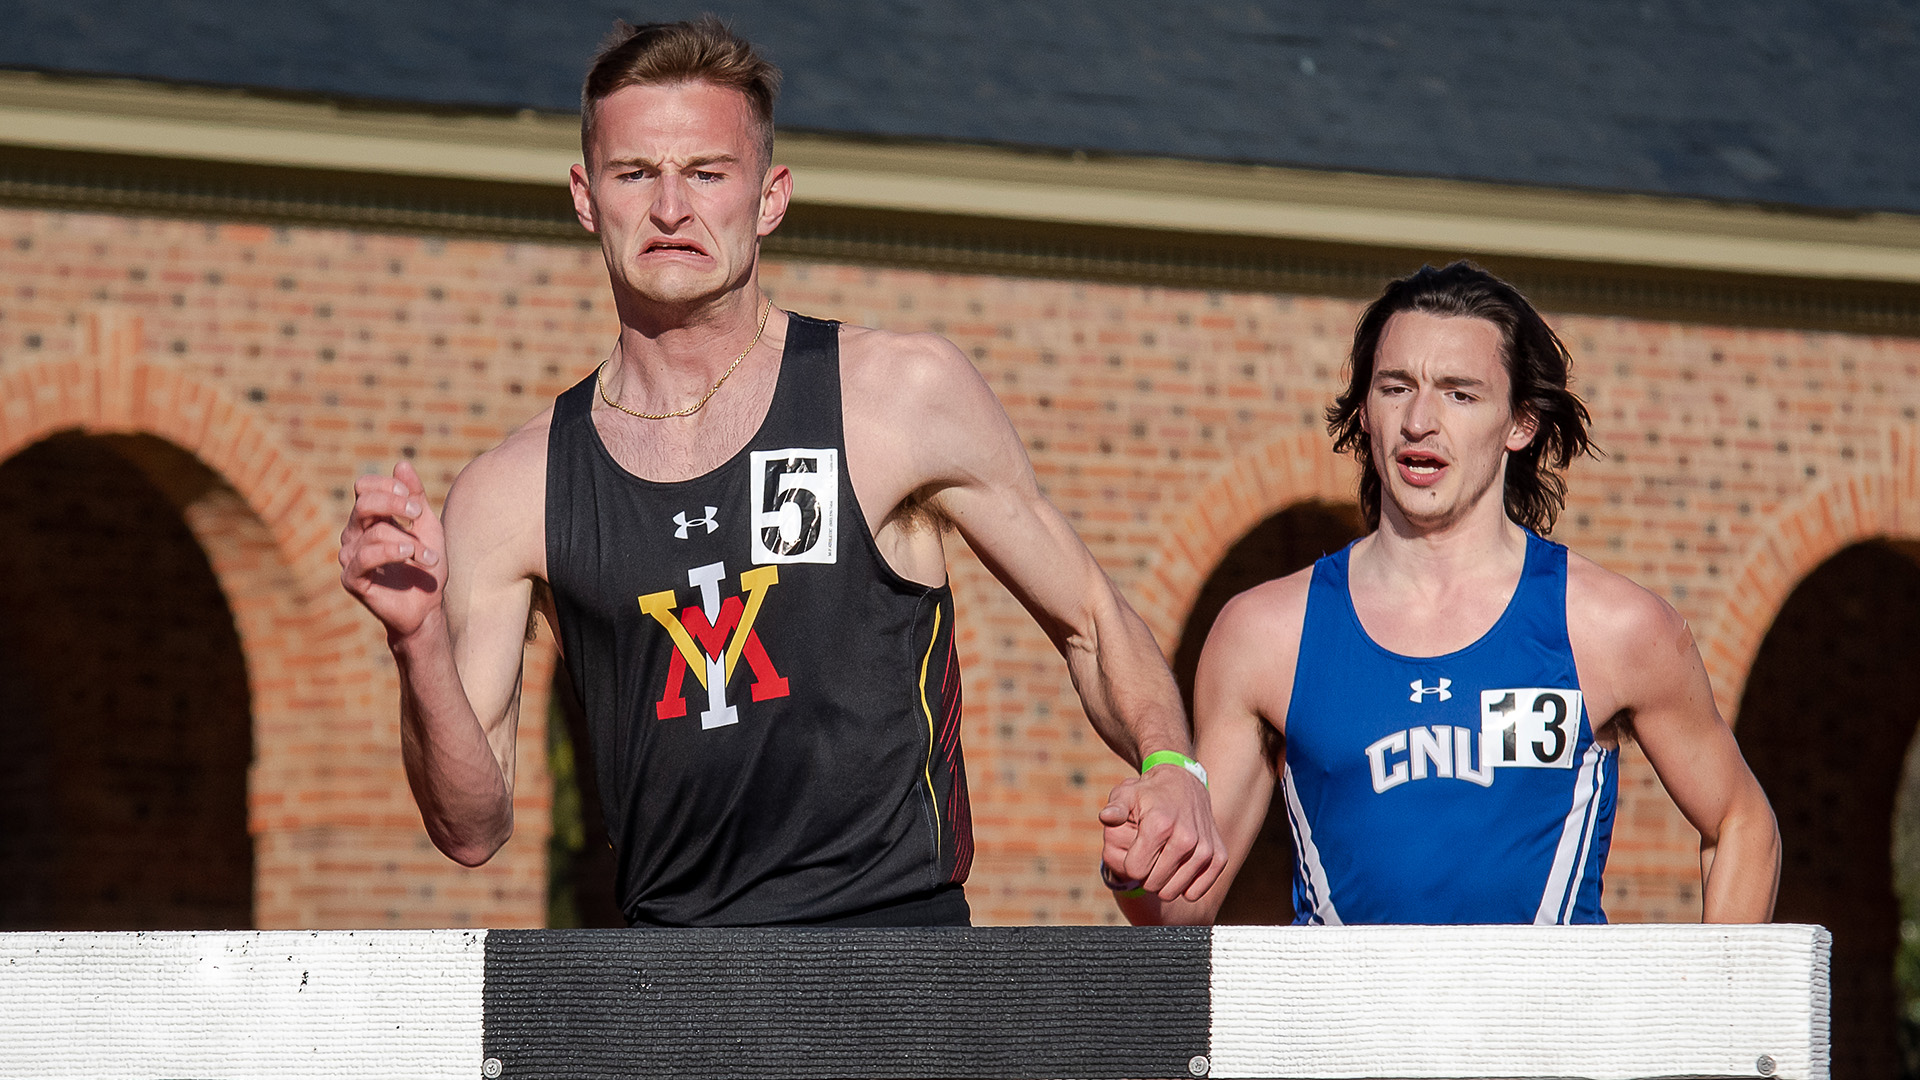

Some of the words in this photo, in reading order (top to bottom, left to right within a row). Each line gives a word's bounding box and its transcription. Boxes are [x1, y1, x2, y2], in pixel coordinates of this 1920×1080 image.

[761, 457, 822, 556] 5
[1364, 724, 1496, 795] CNU
[1489, 692, 1568, 764] 13
